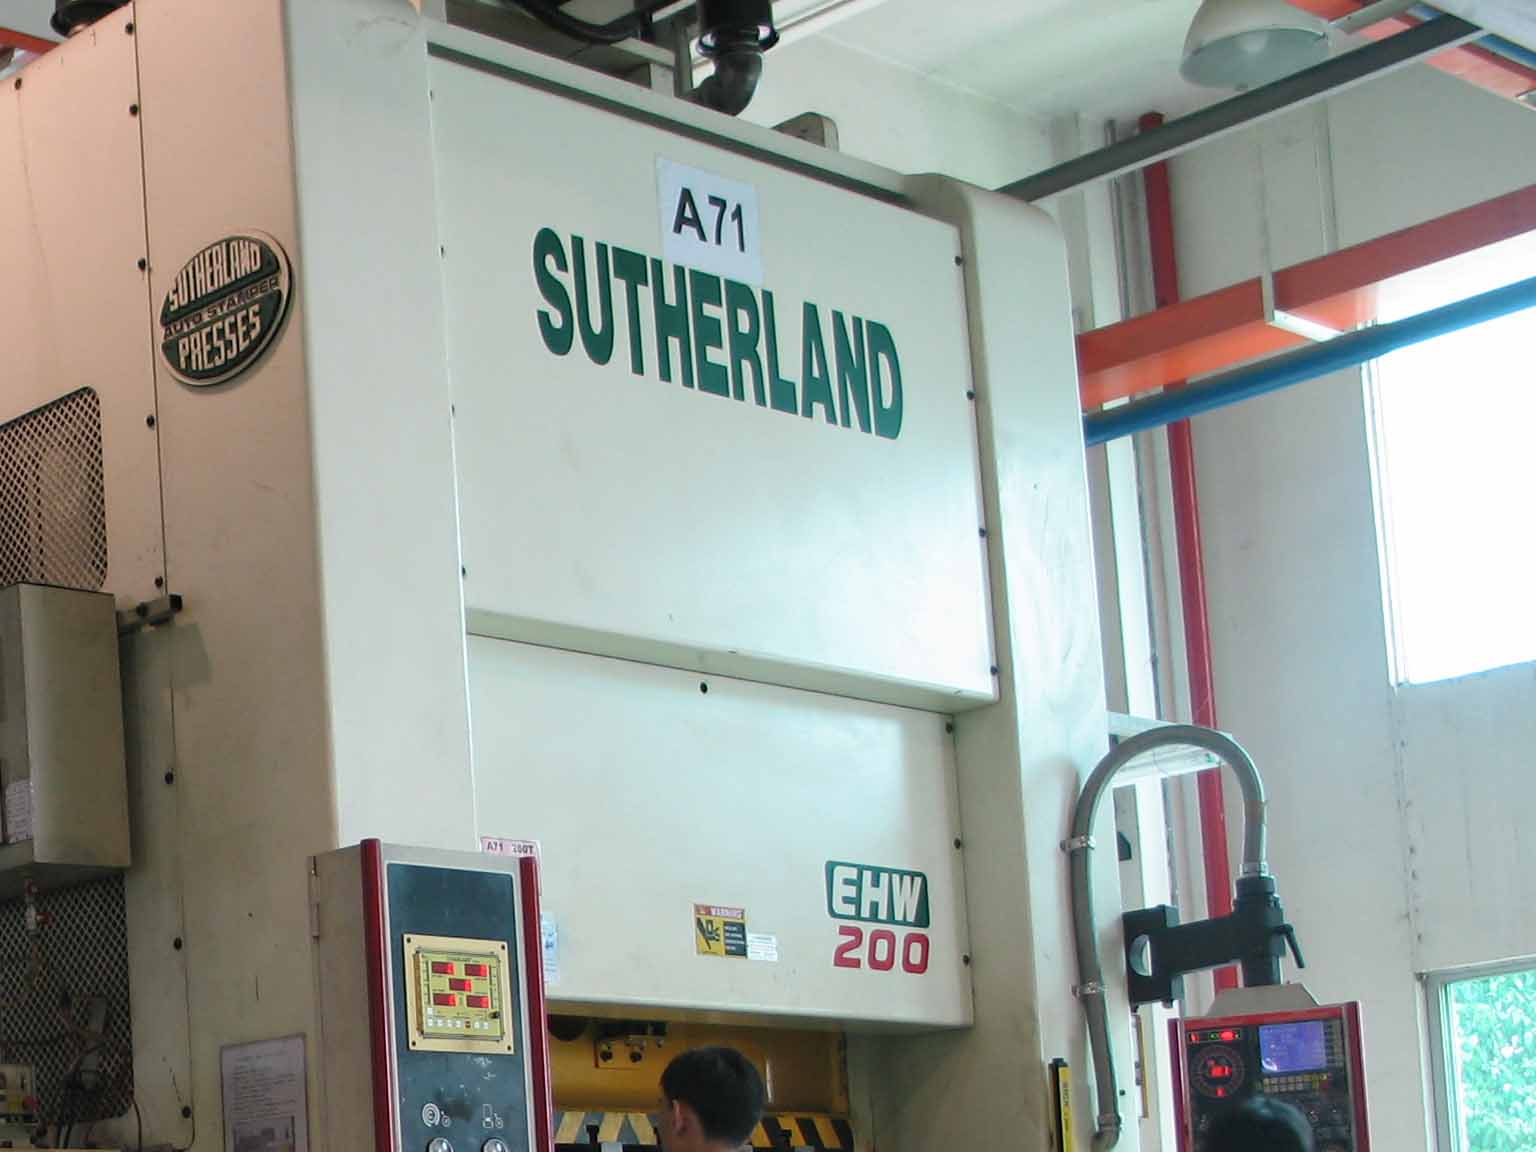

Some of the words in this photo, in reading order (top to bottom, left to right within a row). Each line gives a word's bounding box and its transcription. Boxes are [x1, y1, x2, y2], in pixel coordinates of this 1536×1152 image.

[672, 186, 746, 253] A71
[168, 239, 262, 312] SUTHERLAND
[178, 304, 262, 371] PRESSES
[532, 227, 904, 441] SUTHERLAND
[831, 865, 923, 923] EHW
[833, 925, 930, 974] 200
